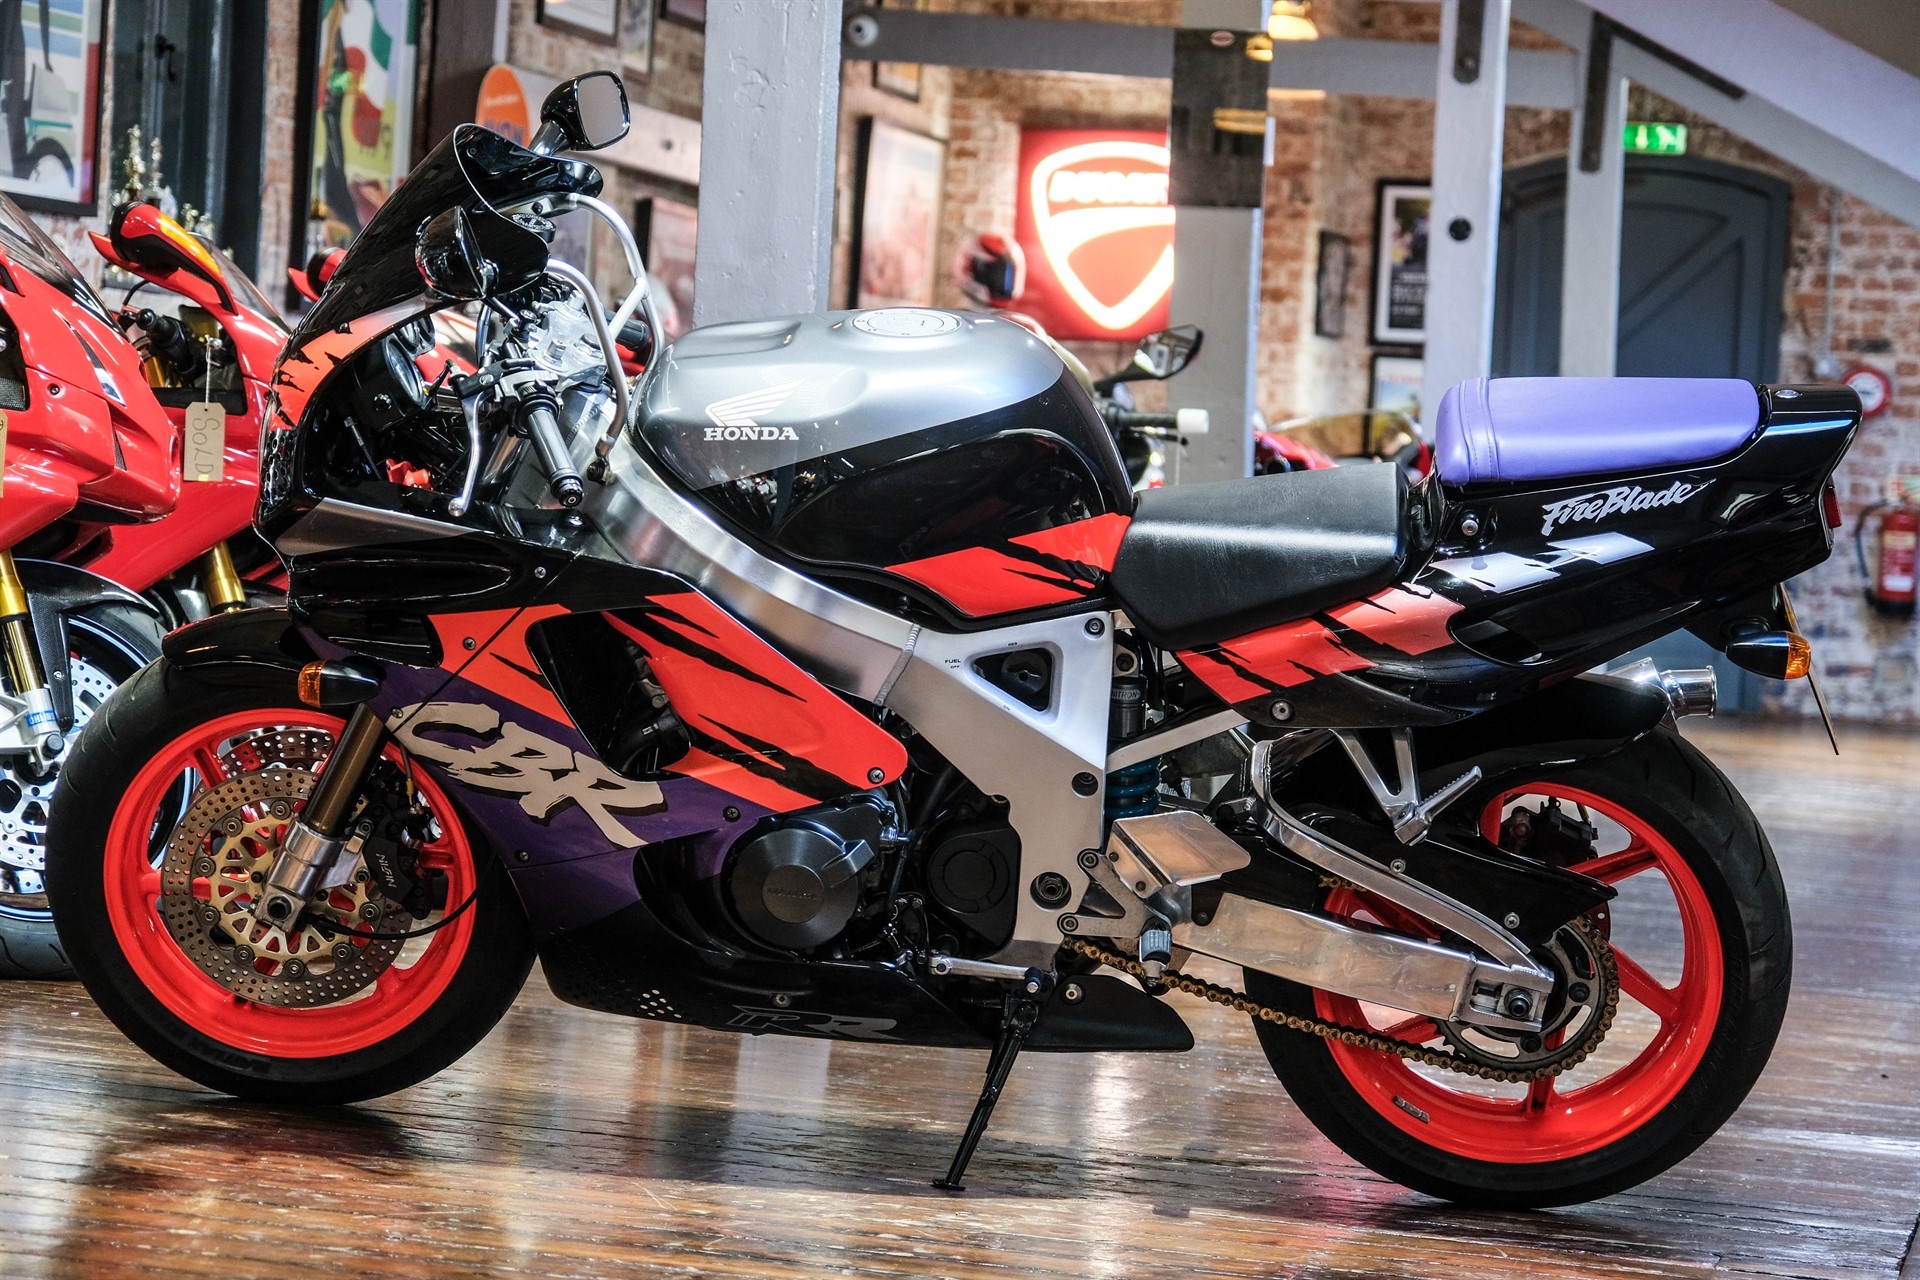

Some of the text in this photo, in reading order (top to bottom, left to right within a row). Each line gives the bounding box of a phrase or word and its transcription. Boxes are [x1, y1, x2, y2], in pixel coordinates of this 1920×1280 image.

[192, 417, 220, 474] SOLD
[703, 427, 799, 441] HONDA
[1541, 480, 1717, 536] FireBlade
[385, 701, 665, 849] CBR
[376, 853, 397, 888] NISSIN
